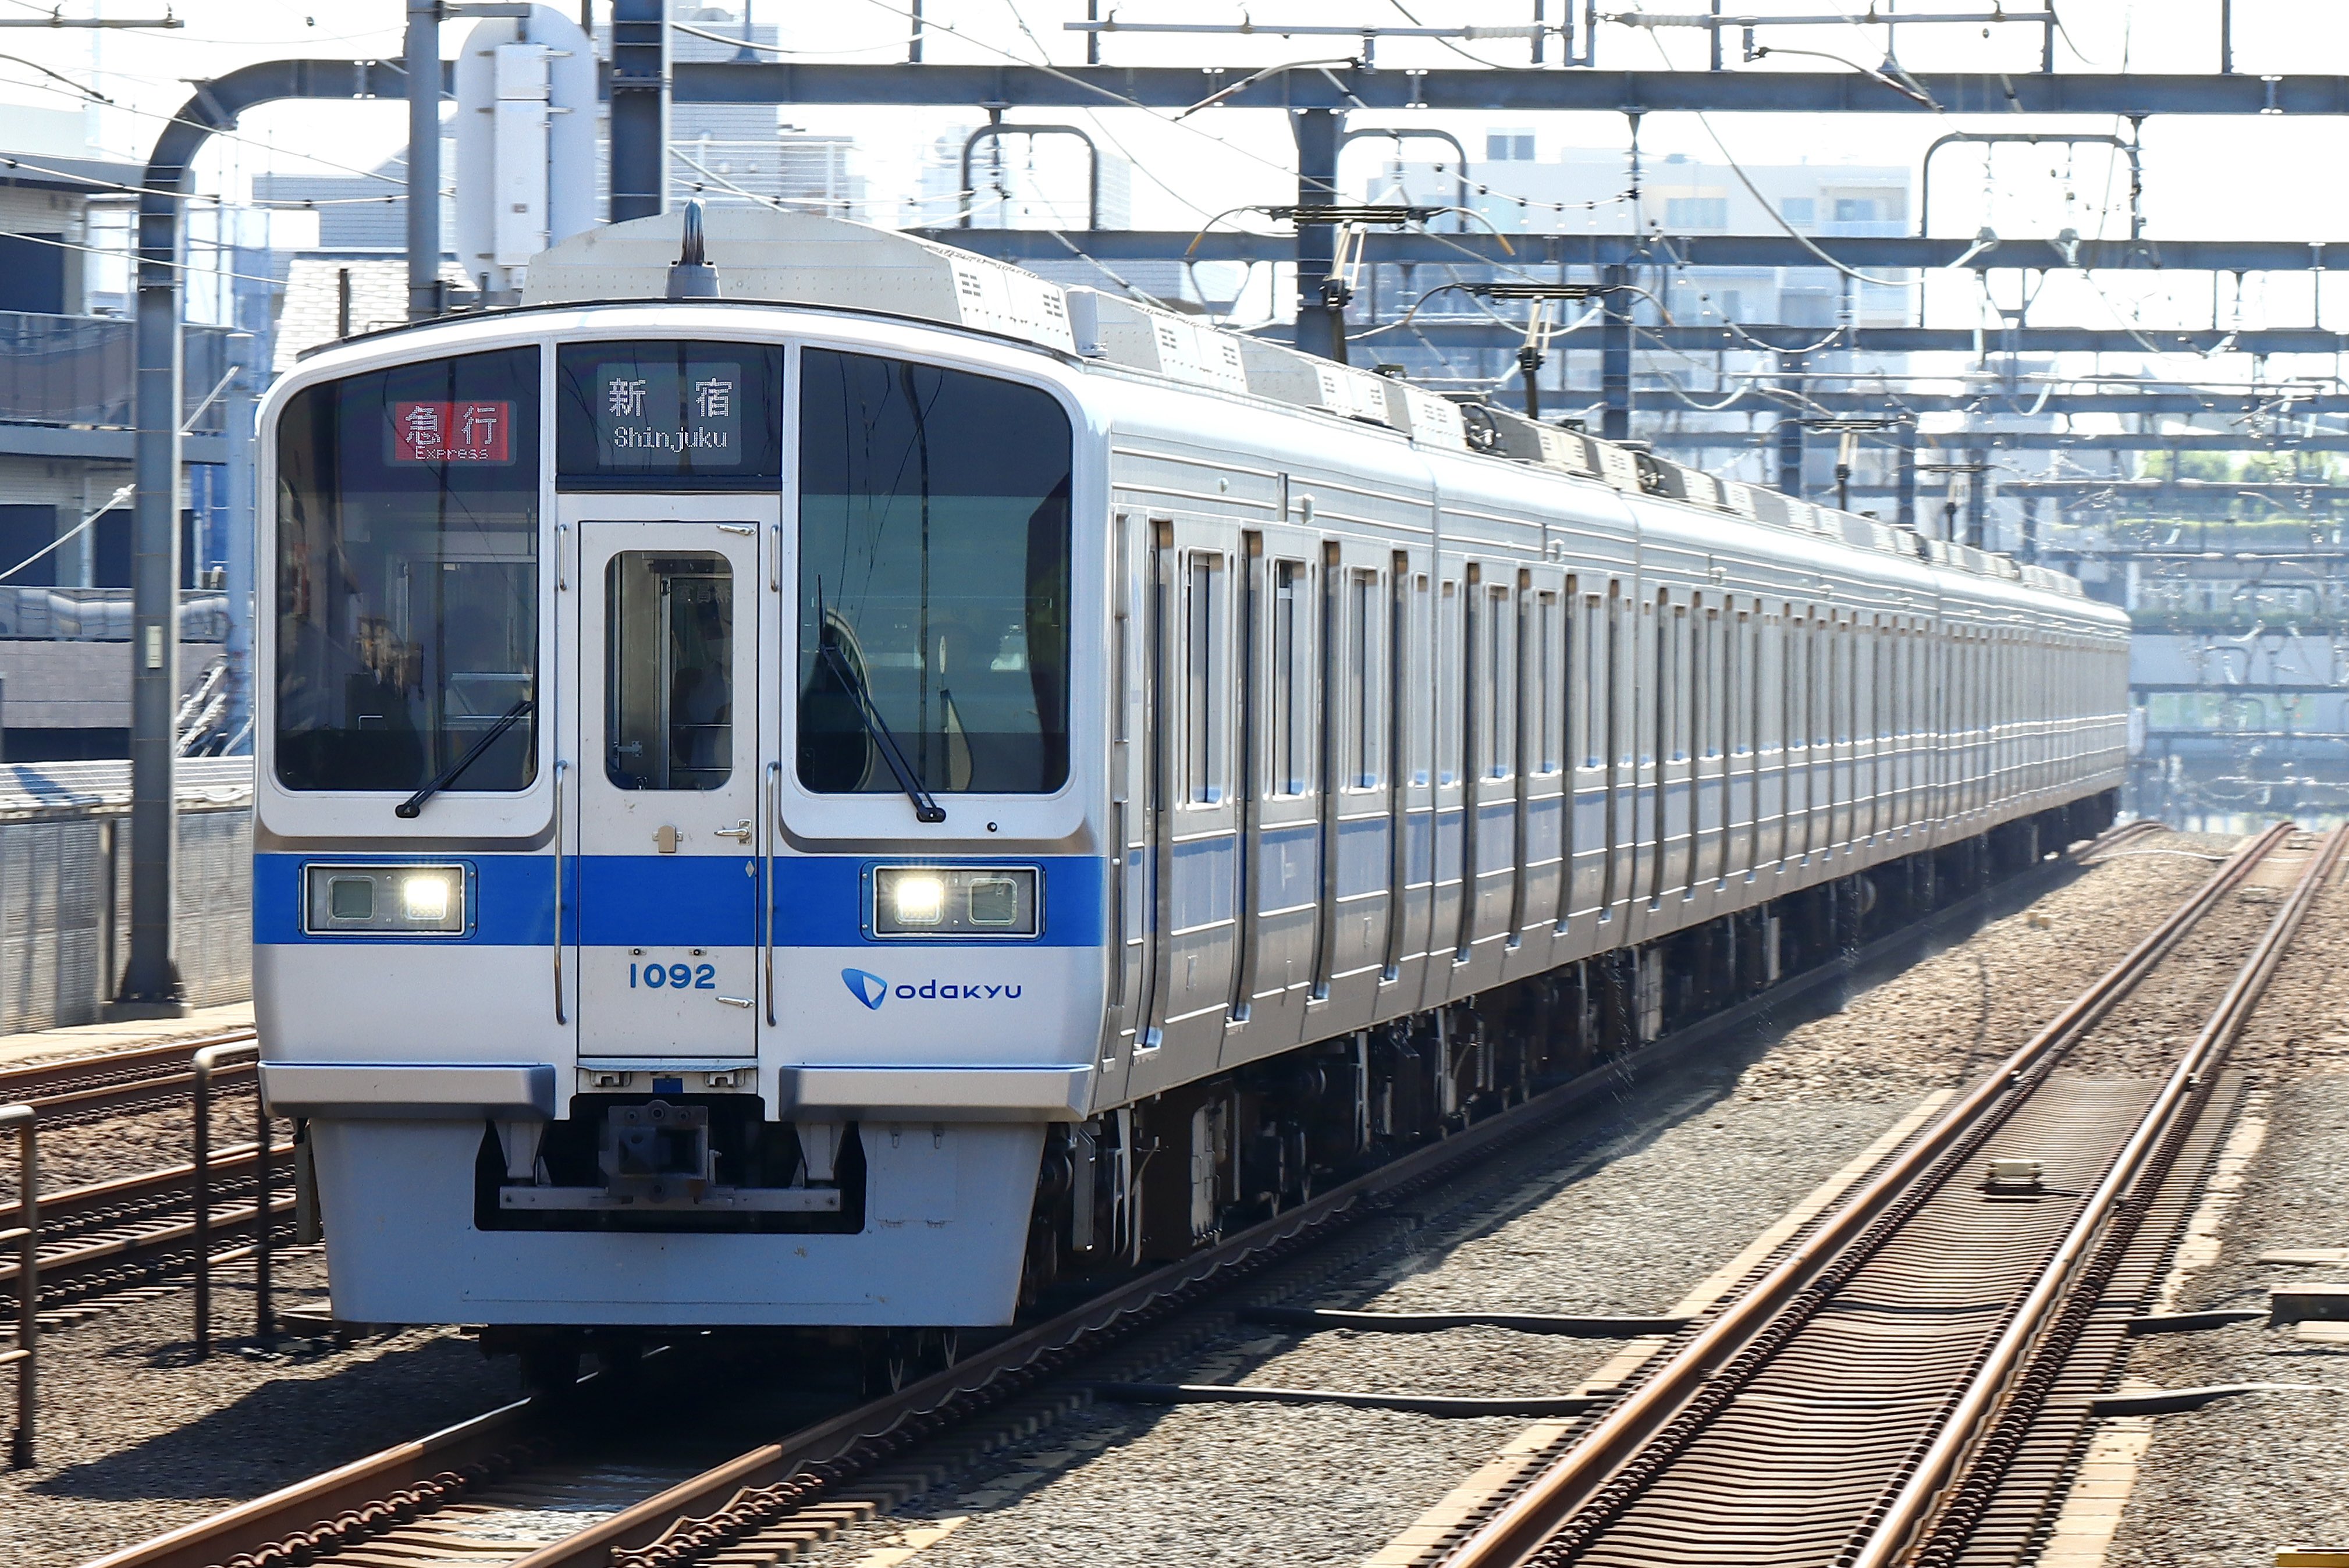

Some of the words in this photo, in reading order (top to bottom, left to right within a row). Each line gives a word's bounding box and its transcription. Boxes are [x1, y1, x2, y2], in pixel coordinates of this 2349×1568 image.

[609, 378, 732, 417] 新宿
[405, 406, 497, 445] 急行
[415, 445, 488, 460] Express
[614, 426, 727, 453] Shinjuku
[630, 963, 715, 989] 1092
[895, 979, 1021, 998] odakyu
